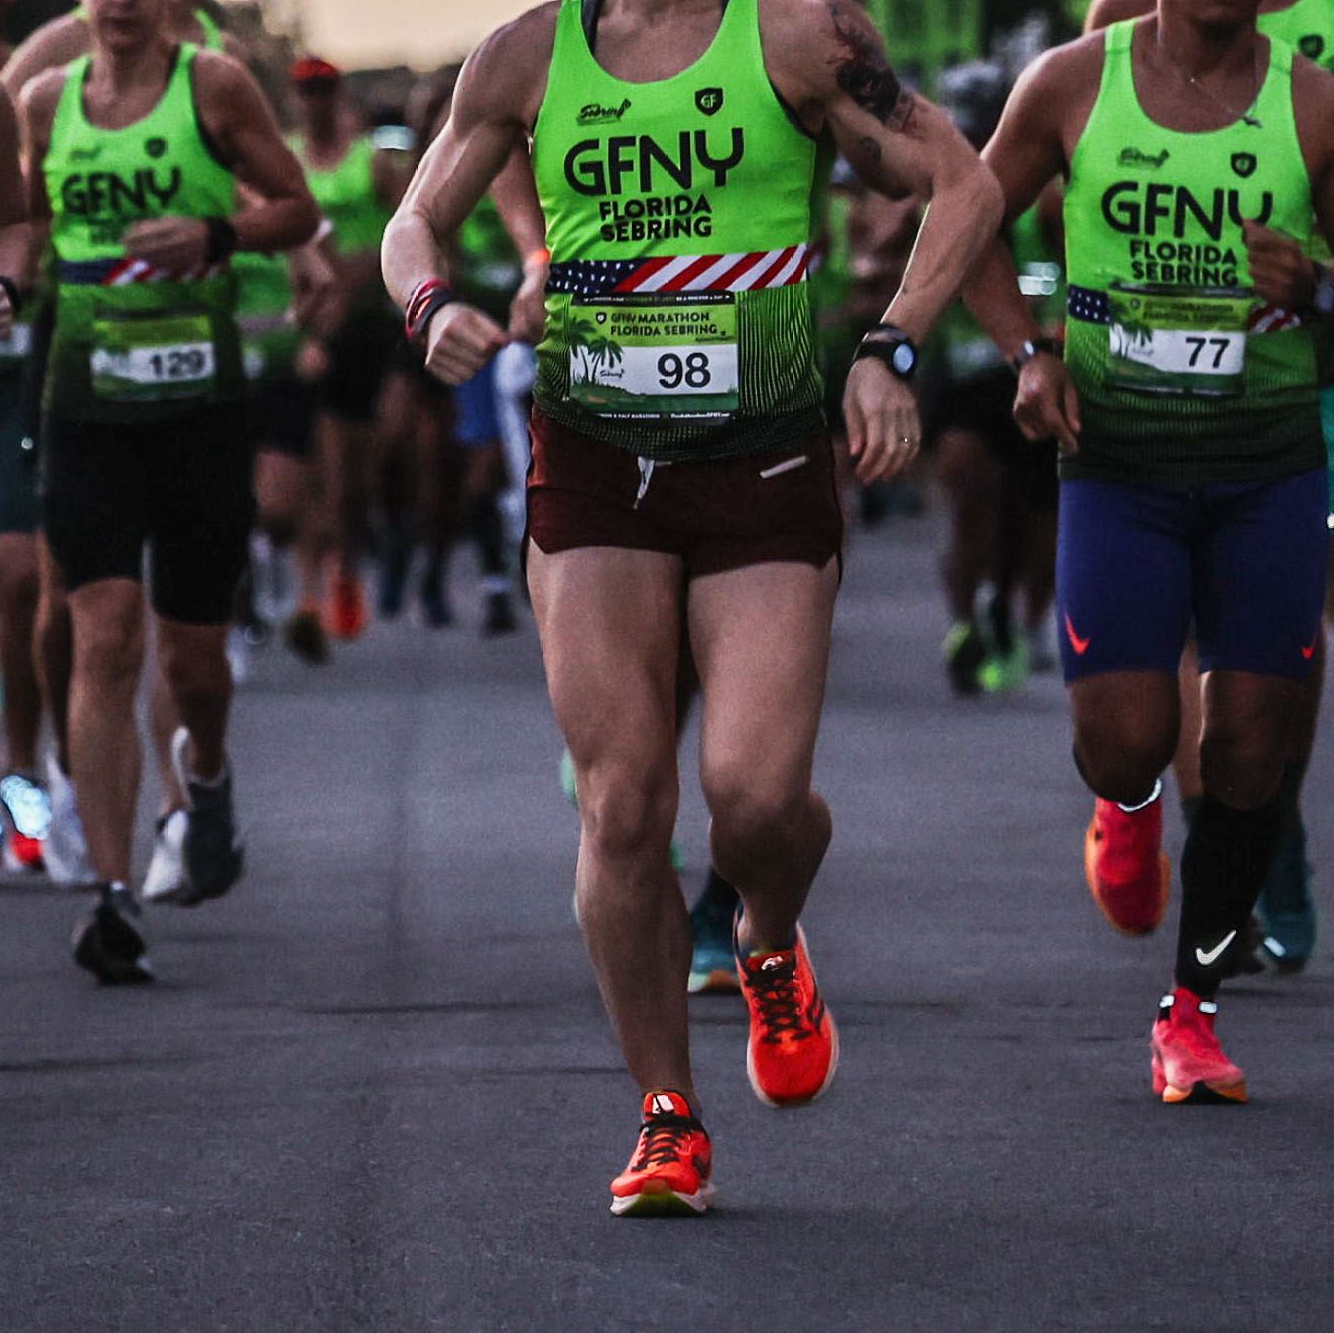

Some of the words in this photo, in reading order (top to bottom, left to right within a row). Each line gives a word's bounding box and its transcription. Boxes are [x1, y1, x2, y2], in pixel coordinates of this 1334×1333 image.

[564, 127, 744, 197] GFNY
[61, 167, 181, 216] GFNY
[598, 194, 712, 220] FLORIDA
[599, 216, 712, 242] SEBRING
[1130, 239, 1238, 266] FLORIDA
[1132, 262, 1239, 286] SEBRING
[611, 324, 661, 337] FLORIDA
[665, 324, 717, 336] SEBRING
[639, 311, 710, 324] MARATHON
[1185, 336, 1230, 368] 77
[657, 352, 712, 389] 98
